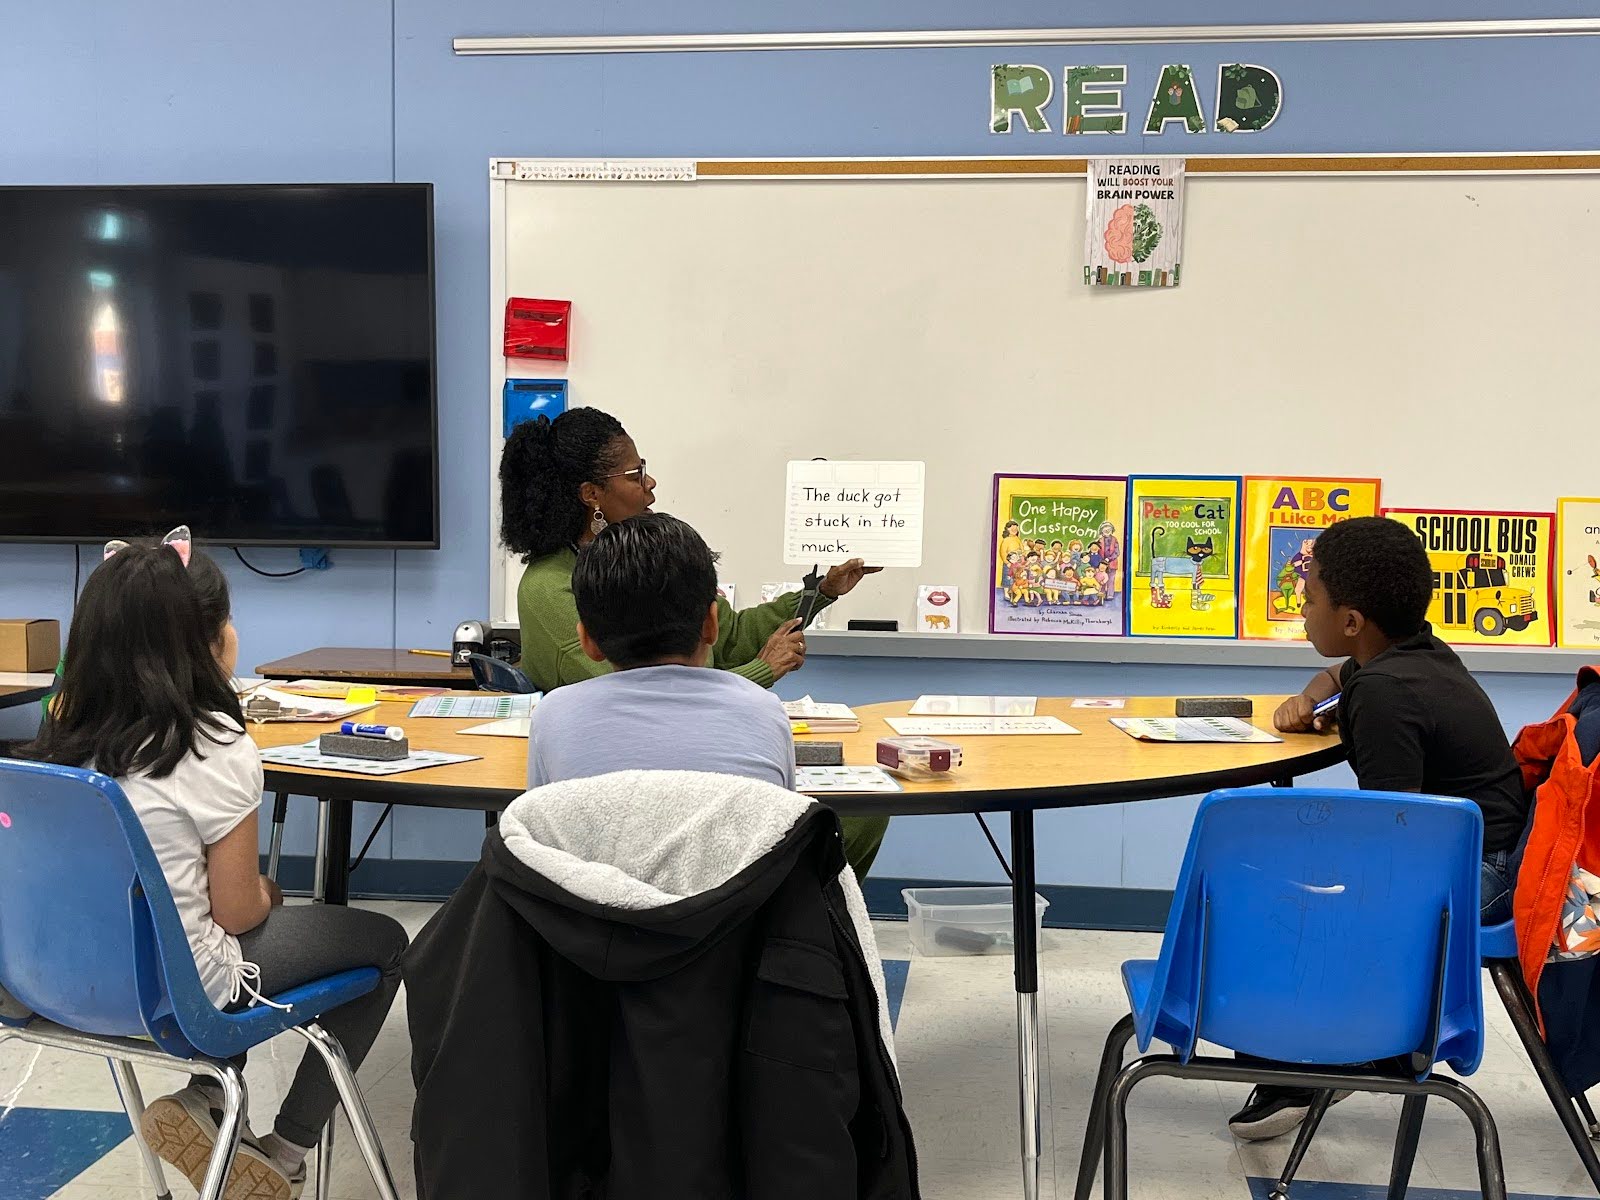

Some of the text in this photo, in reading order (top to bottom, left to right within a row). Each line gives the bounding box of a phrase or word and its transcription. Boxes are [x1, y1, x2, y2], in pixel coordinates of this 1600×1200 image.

[989, 63, 1284, 135] READ
[1108, 165, 1160, 176] READING
[1097, 178, 1174, 187] WILL BOOST YOUR
[1097, 190, 1174, 200] BRAIN POWER
[802, 487, 901, 508] The duck got
[1272, 486, 1350, 512] ABC
[1019, 500, 1099, 523] One Happy
[1144, 501, 1225, 520] Pete the Cat
[804, 512, 905, 528] stuck in the
[1165, 520, 1180, 528] TOO
[1201, 520, 1216, 528] FOR
[1269, 511, 1275, 523] I
[1280, 512, 1316, 525] Like
[1020, 517, 1098, 539] Classroom
[1194, 527, 1222, 536] SCHOOL
[1415, 516, 1538, 553] SCHOOL BUS
[801, 539, 850, 553] muck.
[1509, 554, 1536, 566] DONALD
[1511, 566, 1536, 578] CREWS
